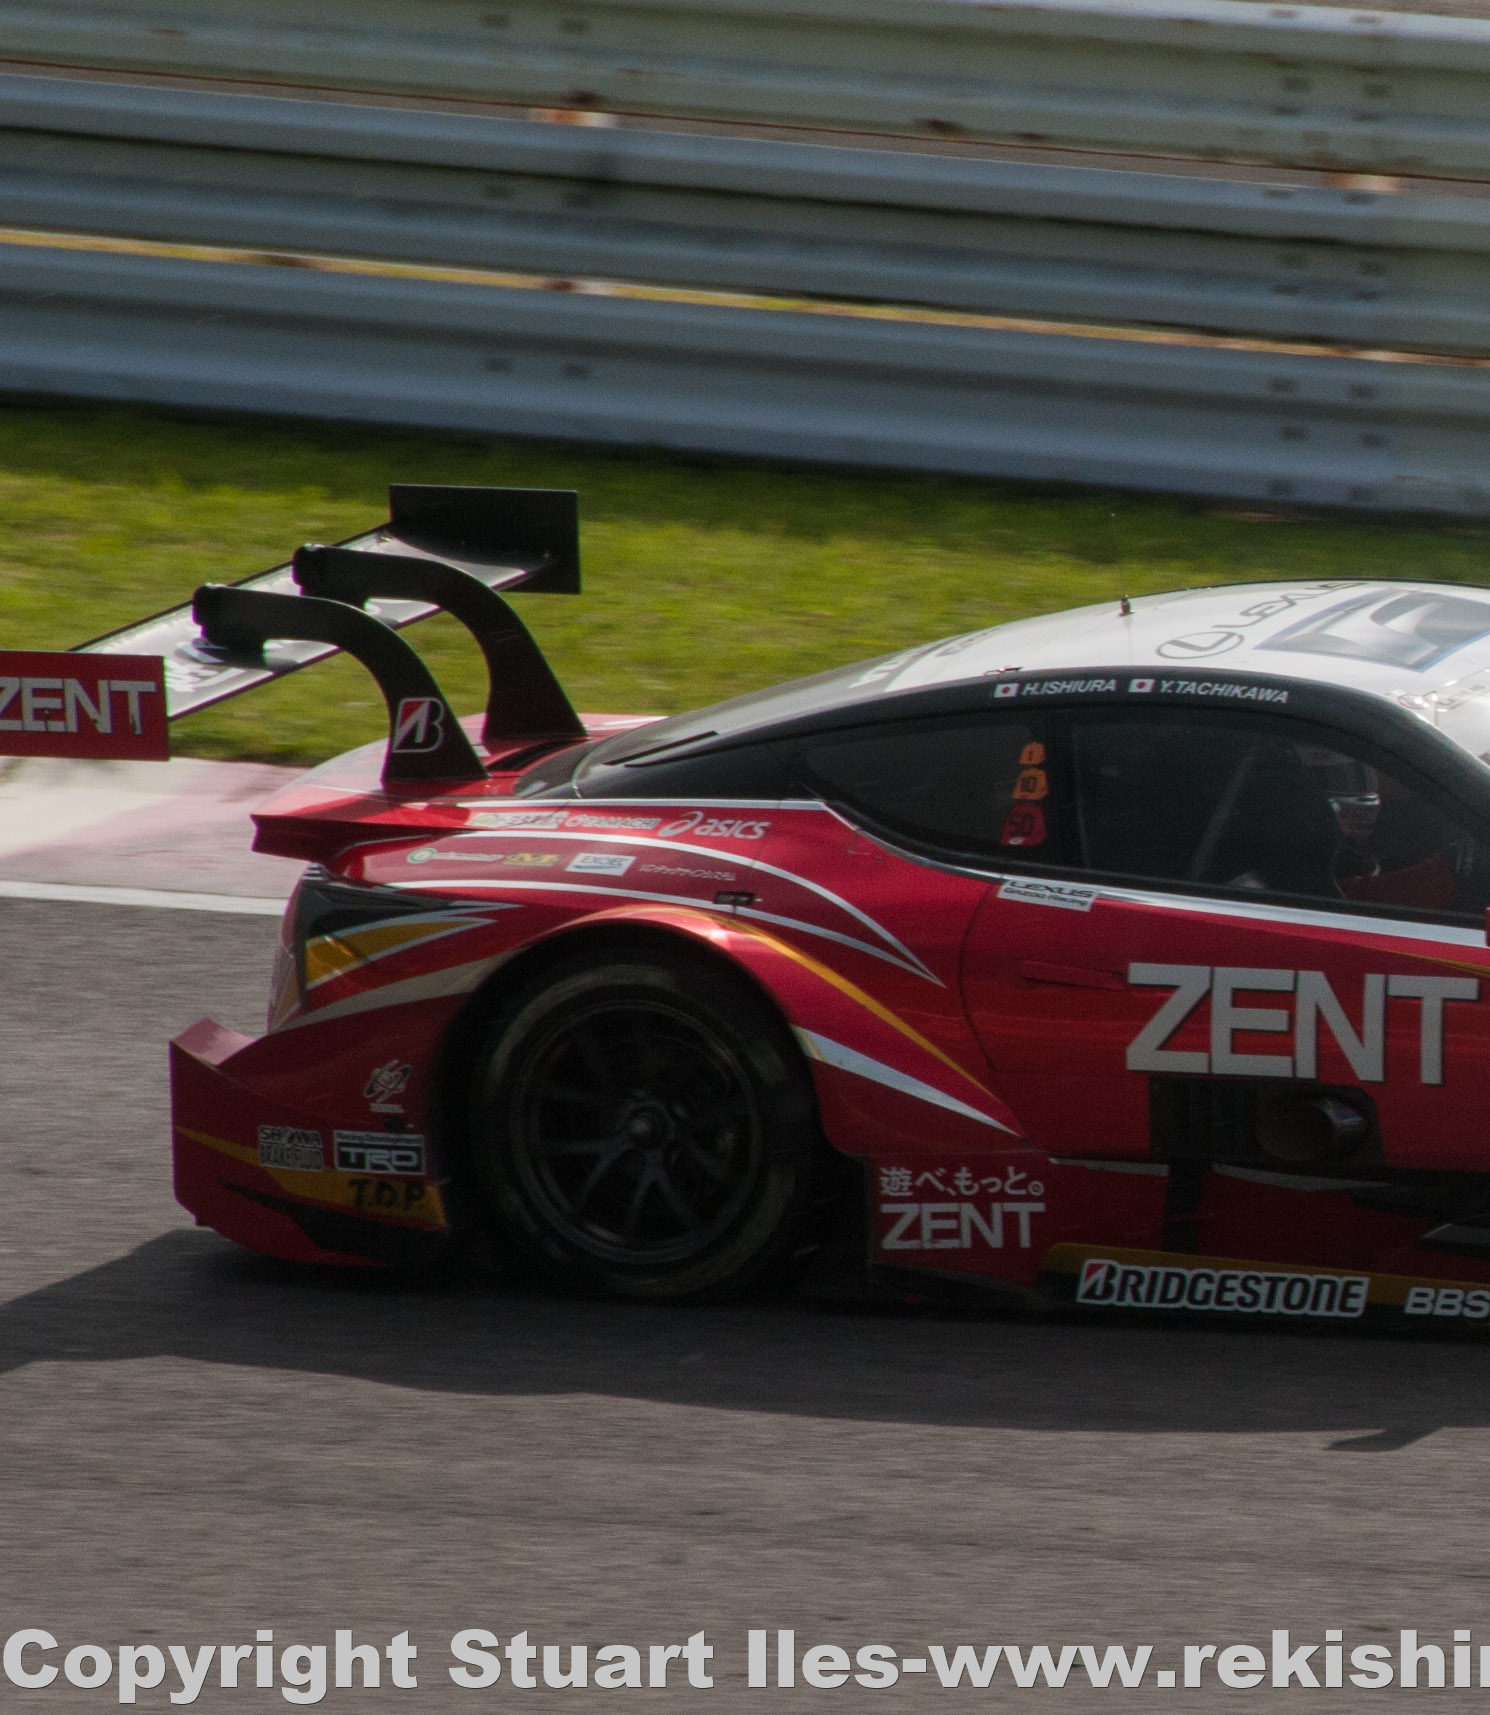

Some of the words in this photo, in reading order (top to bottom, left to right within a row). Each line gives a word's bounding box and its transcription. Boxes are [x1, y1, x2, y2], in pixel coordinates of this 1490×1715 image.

[1021, 679, 1117, 696] H.ISHIURA
[1160, 679, 1289, 703] Y.TACHIKAWA
[694, 818, 771, 840] asics
[1009, 881, 1094, 899] LEXUS
[1126, 962, 1480, 1085] ZENT
[339, 1146, 419, 1173] TRD
[879, 1202, 1046, 1250] ZENT
[1081, 1262, 1367, 1317] BRIDGESTONE
